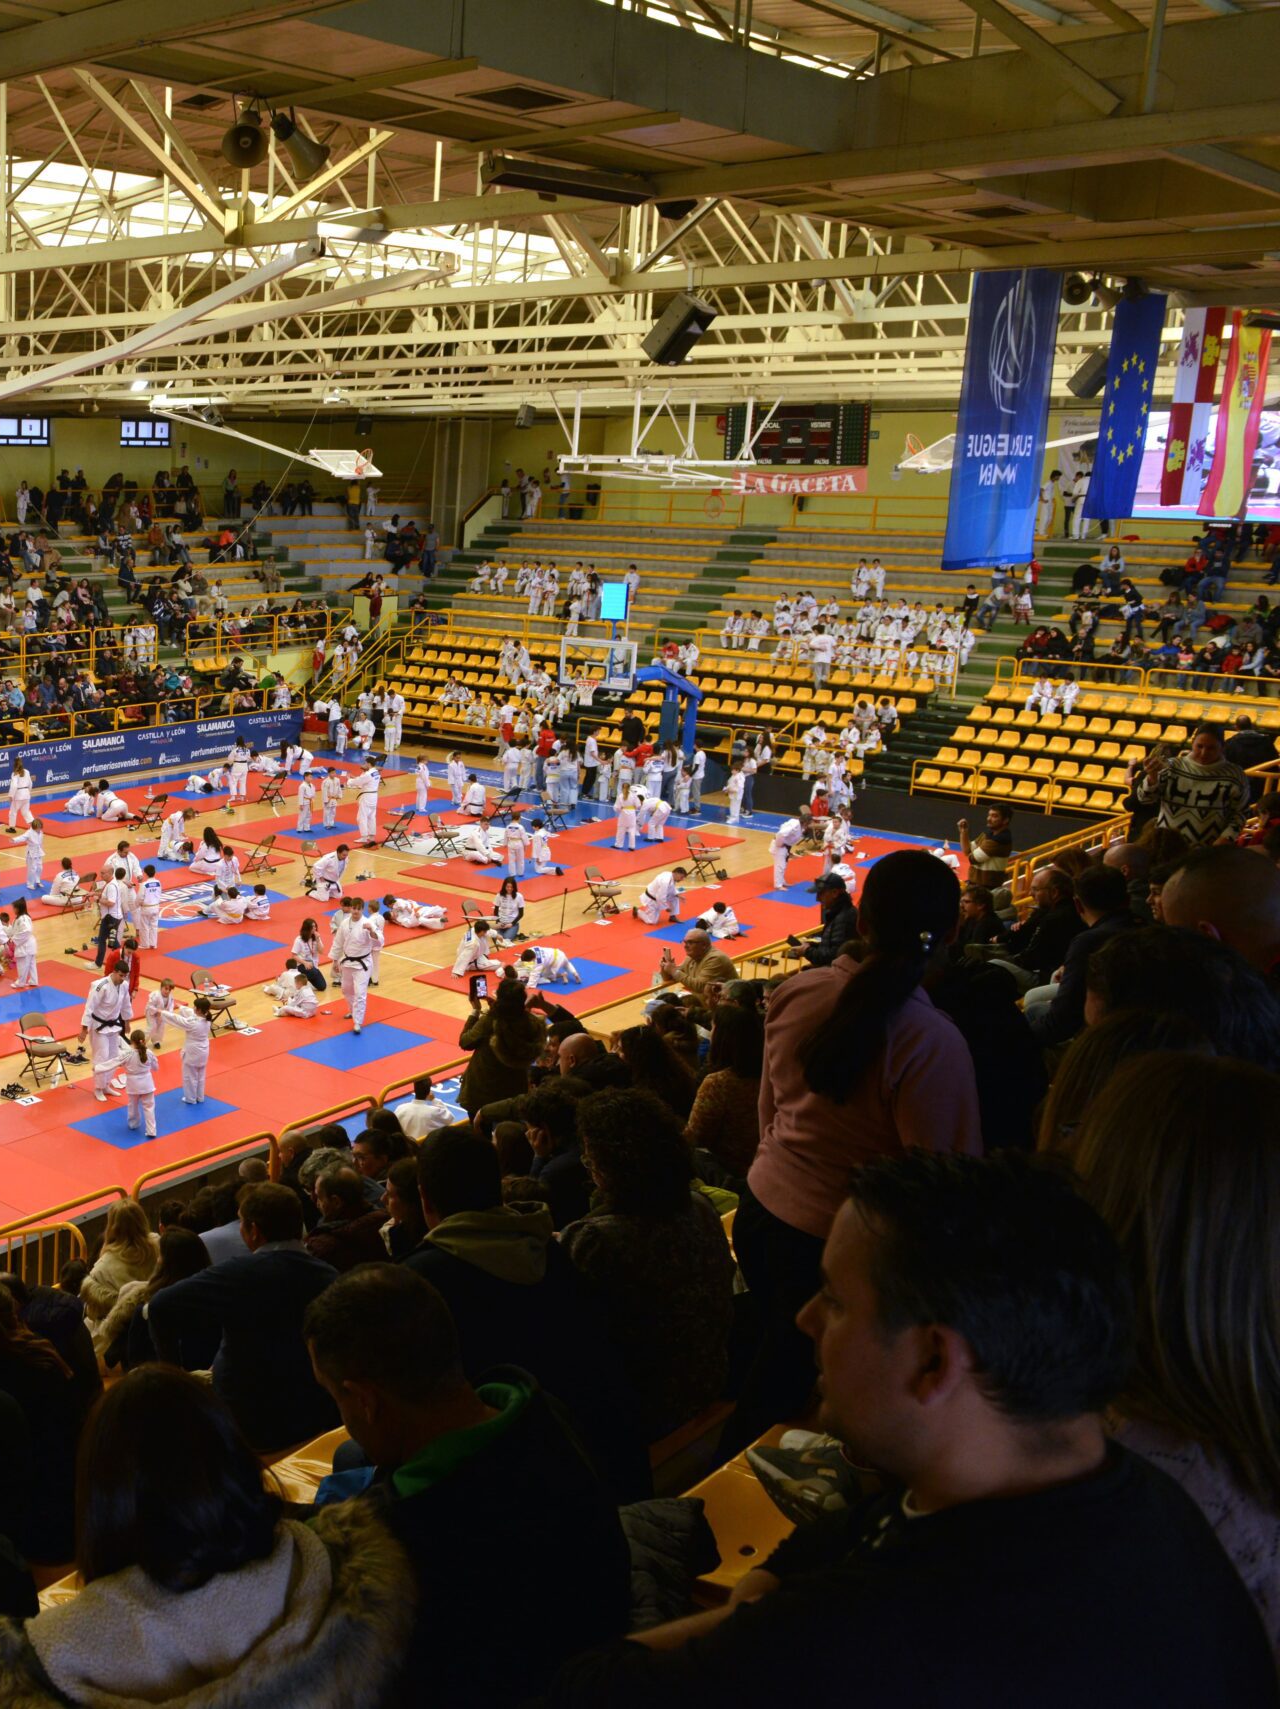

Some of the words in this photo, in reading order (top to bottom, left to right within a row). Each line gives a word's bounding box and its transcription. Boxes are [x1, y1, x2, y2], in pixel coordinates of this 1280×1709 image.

[771, 474, 858, 494] GACETA
[196, 720, 235, 733] SALAMANCA
[248, 716, 272, 725] CASTILLA
[82, 735, 125, 749] SALAMANCA
[137, 731, 164, 741] CASTILLA
[166, 730, 171, 738] Y
[17, 748, 47, 758] CASTILLA
[49, 746, 54, 755] Y
[55, 743, 72, 752] LEÓN
[82, 757, 153, 776] perfumeriasavenida.com
